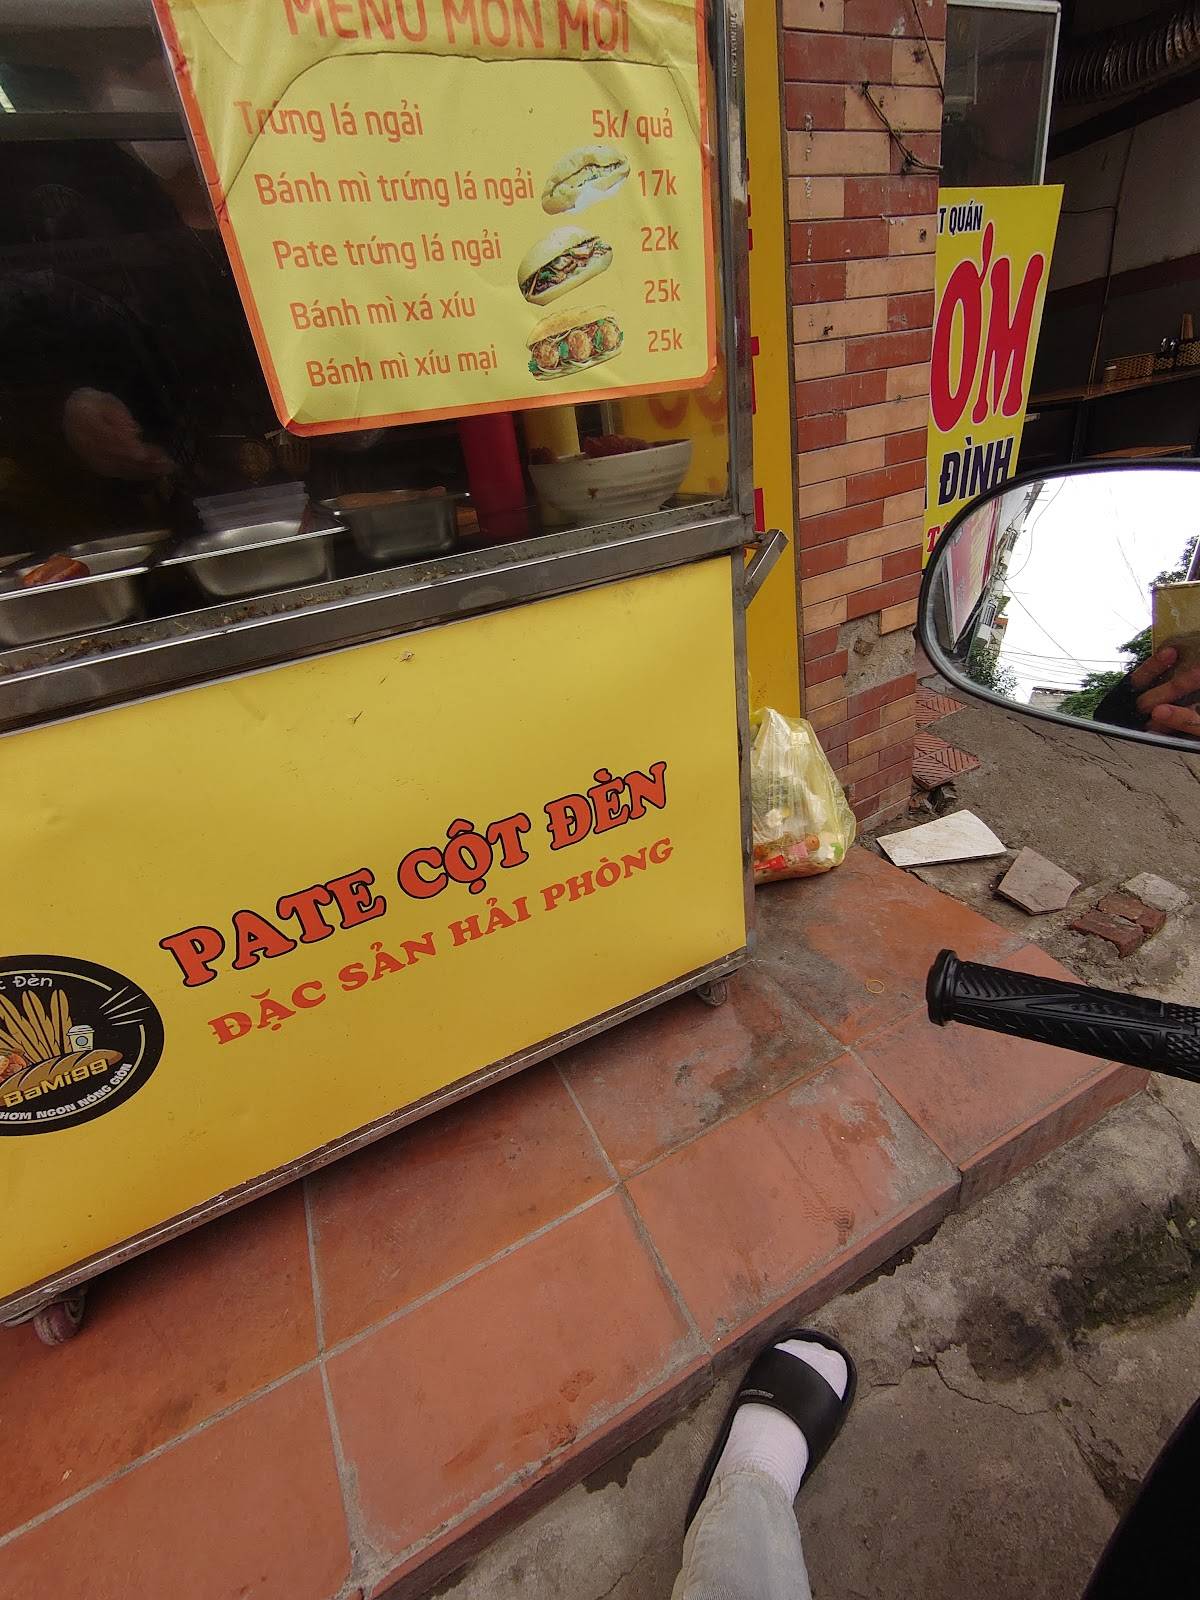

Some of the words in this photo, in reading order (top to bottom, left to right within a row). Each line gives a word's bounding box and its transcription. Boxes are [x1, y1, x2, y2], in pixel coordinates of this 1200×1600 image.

[234, 99, 326, 143] Trứng
[330, 102, 358, 135] lá
[365, 99, 424, 143] ngải
[591, 109, 629, 139] 5k/
[635, 108, 673, 139] quả
[254, 171, 332, 205] Bánh
[337, 170, 371, 202] mì
[376, 170, 450, 207] trứng
[454, 170, 478, 201] lá
[483, 167, 534, 206] ngải
[637, 169, 677, 197] 17k
[949, 200, 983, 236] QUÁN
[272, 240, 338, 270] Pate
[343, 235, 417, 270] trứng
[421, 232, 445, 262] lá
[451, 228, 502, 267] ngải
[640, 226, 679, 252] 22k
[289, 298, 361, 331] Bánh
[366, 295, 398, 325] mì
[403, 293, 434, 322] xá
[439, 290, 476, 319] xíu
[643, 279, 681, 304] 25k
[305, 356, 374, 388] Bánh
[380, 352, 409, 380] mì
[414, 349, 451, 377] xíu
[457, 344, 498, 376] mại
[647, 329, 684, 354] 25k
[938, 436, 1015, 506] ĐÌNH
[159, 868, 387, 988] PATE
[397, 812, 531, 895] CỘT
[547, 761, 667, 851] ĐÈN
[207, 988, 326, 1045] ĐẶC
[338, 932, 436, 992] SẢN
[448, 897, 532, 947] HẢI
[540, 838, 674, 911] PHÒNG
[12, 973, 53, 988] Đèn
[36, 1103, 77, 1119] NGON
